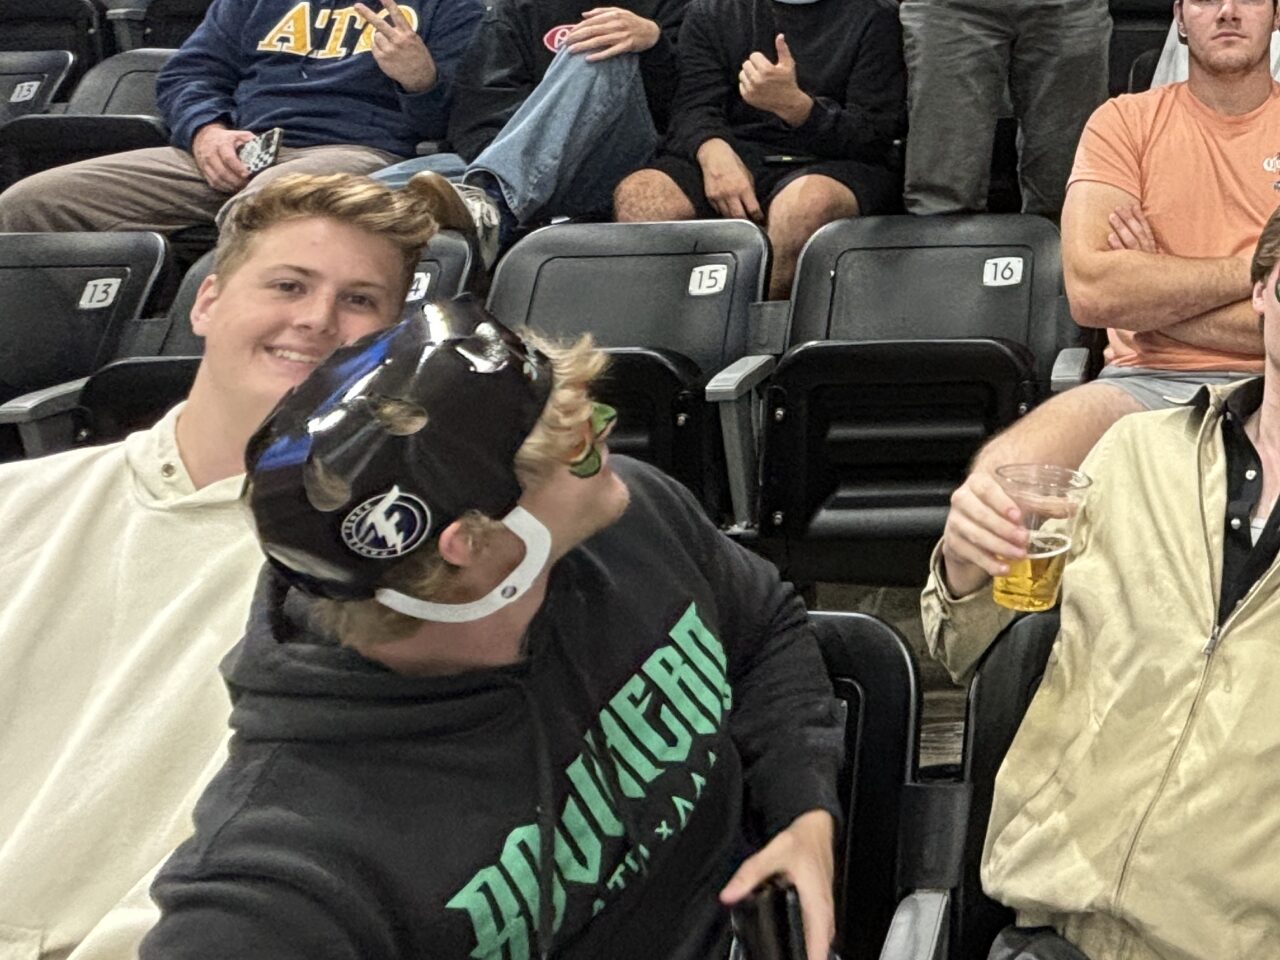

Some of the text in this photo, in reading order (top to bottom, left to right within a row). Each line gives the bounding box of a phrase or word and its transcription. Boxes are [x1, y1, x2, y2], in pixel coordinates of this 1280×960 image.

[697, 269, 719, 290] 15
[992, 262, 1014, 281] 16
[88, 282, 110, 304] 13
